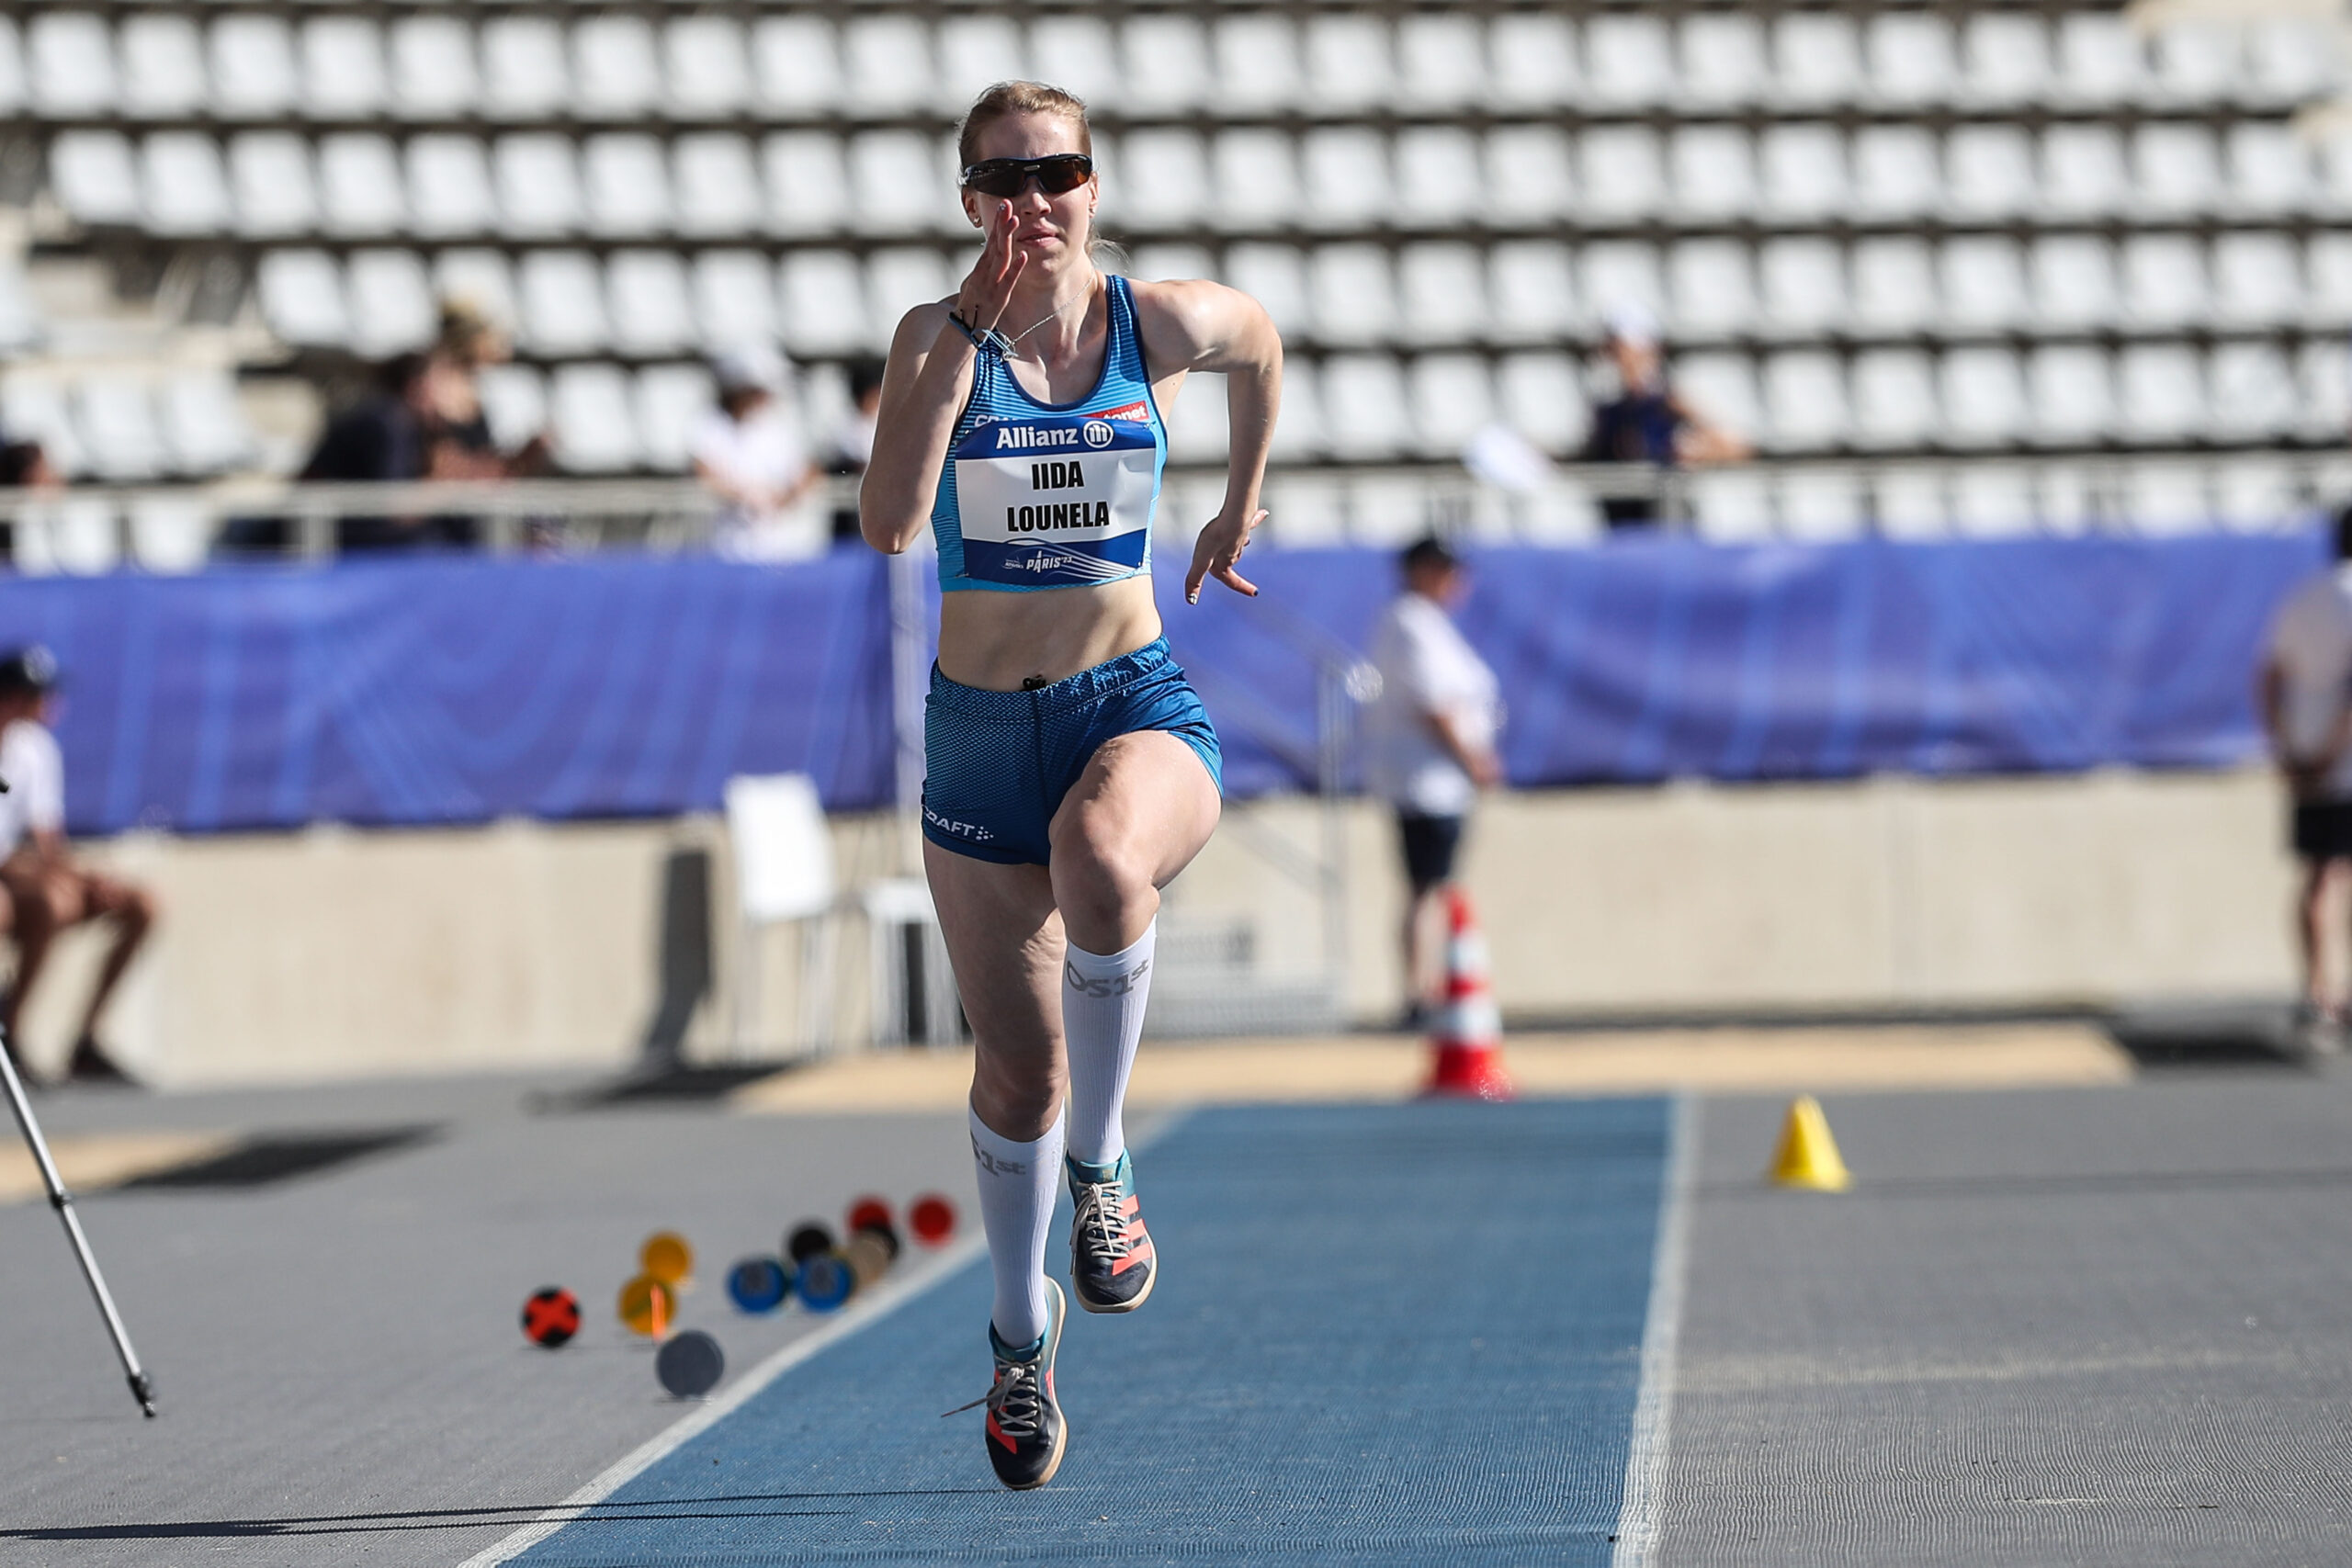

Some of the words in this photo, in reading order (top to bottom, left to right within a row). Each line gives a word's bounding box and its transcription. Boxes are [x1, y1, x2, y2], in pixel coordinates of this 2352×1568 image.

[996, 426, 1079, 449] Allianz
[1032, 461, 1084, 490] IIDA
[1007, 502, 1110, 532] LOUNELA
